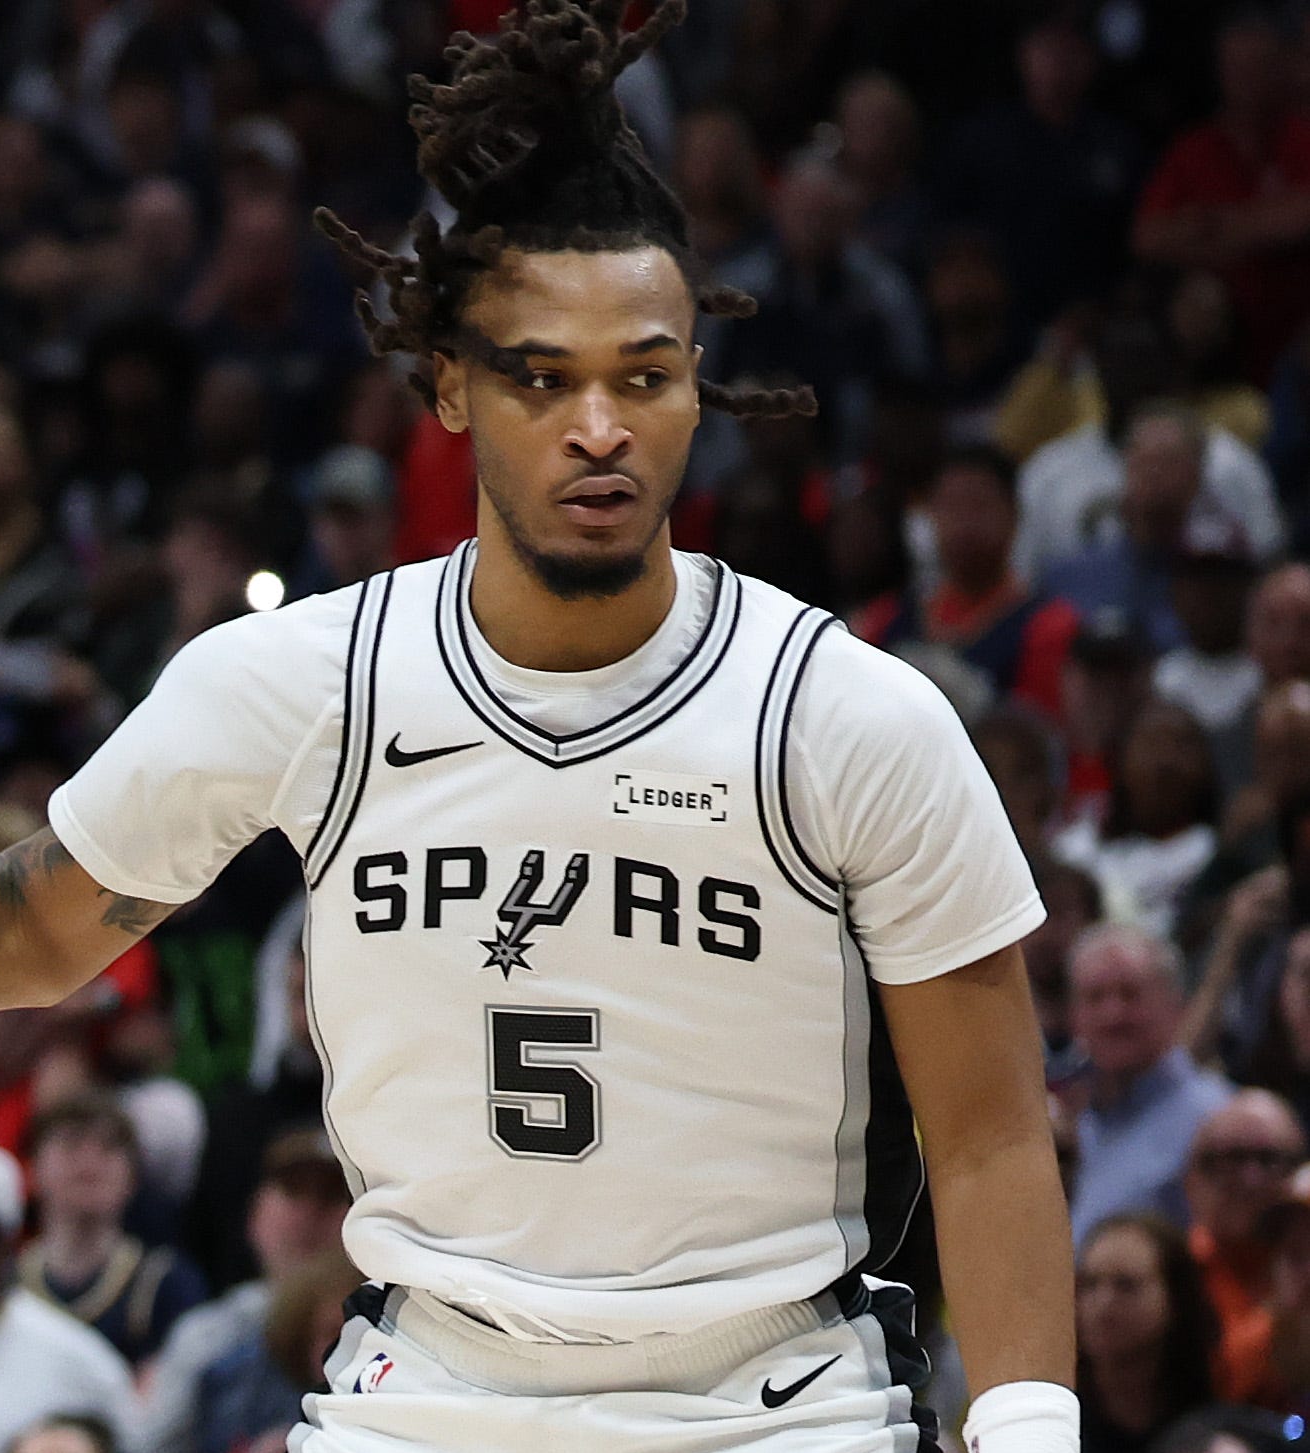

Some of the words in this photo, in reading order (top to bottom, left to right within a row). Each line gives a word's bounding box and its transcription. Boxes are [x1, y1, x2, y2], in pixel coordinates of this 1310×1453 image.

[629, 786, 712, 810] LEDGER
[353, 845, 762, 980] SPURS
[484, 1003, 601, 1161] 5
